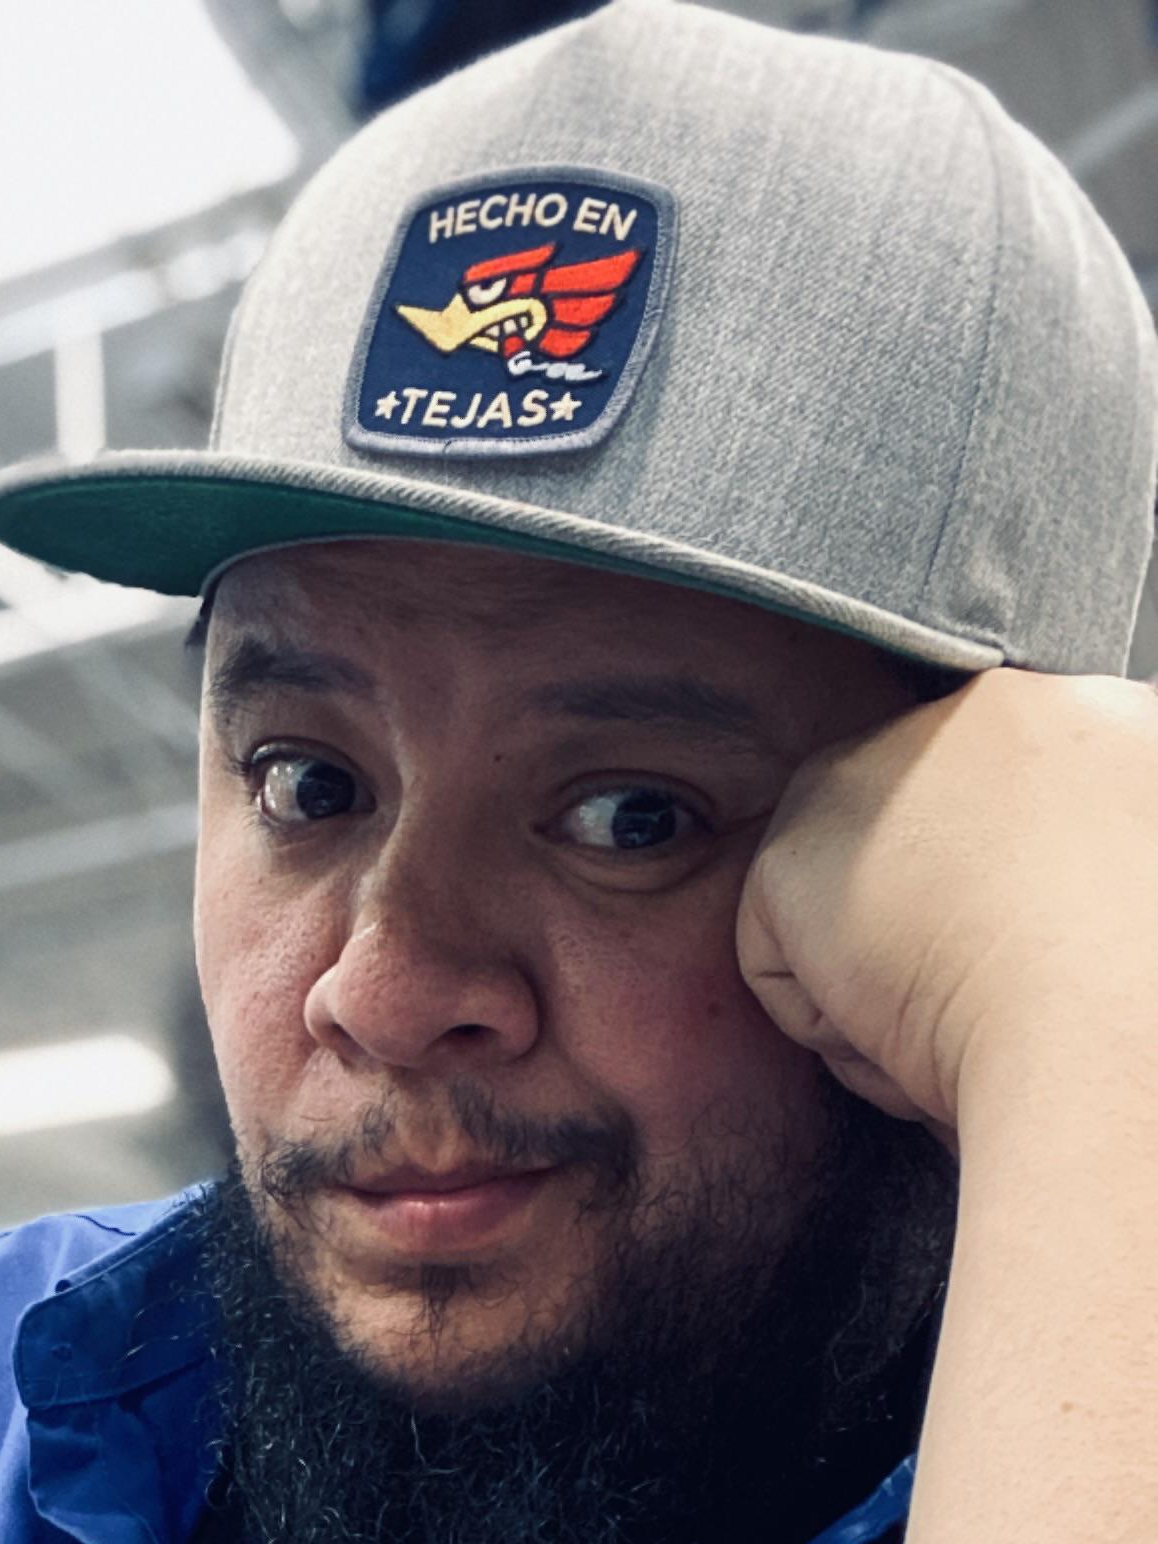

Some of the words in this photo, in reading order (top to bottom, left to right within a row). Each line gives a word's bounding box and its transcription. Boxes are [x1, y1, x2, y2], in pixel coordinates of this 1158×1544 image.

[429, 192, 568, 243] HECHO
[573, 198, 637, 241] EN
[399, 388, 550, 429] TEJAS
